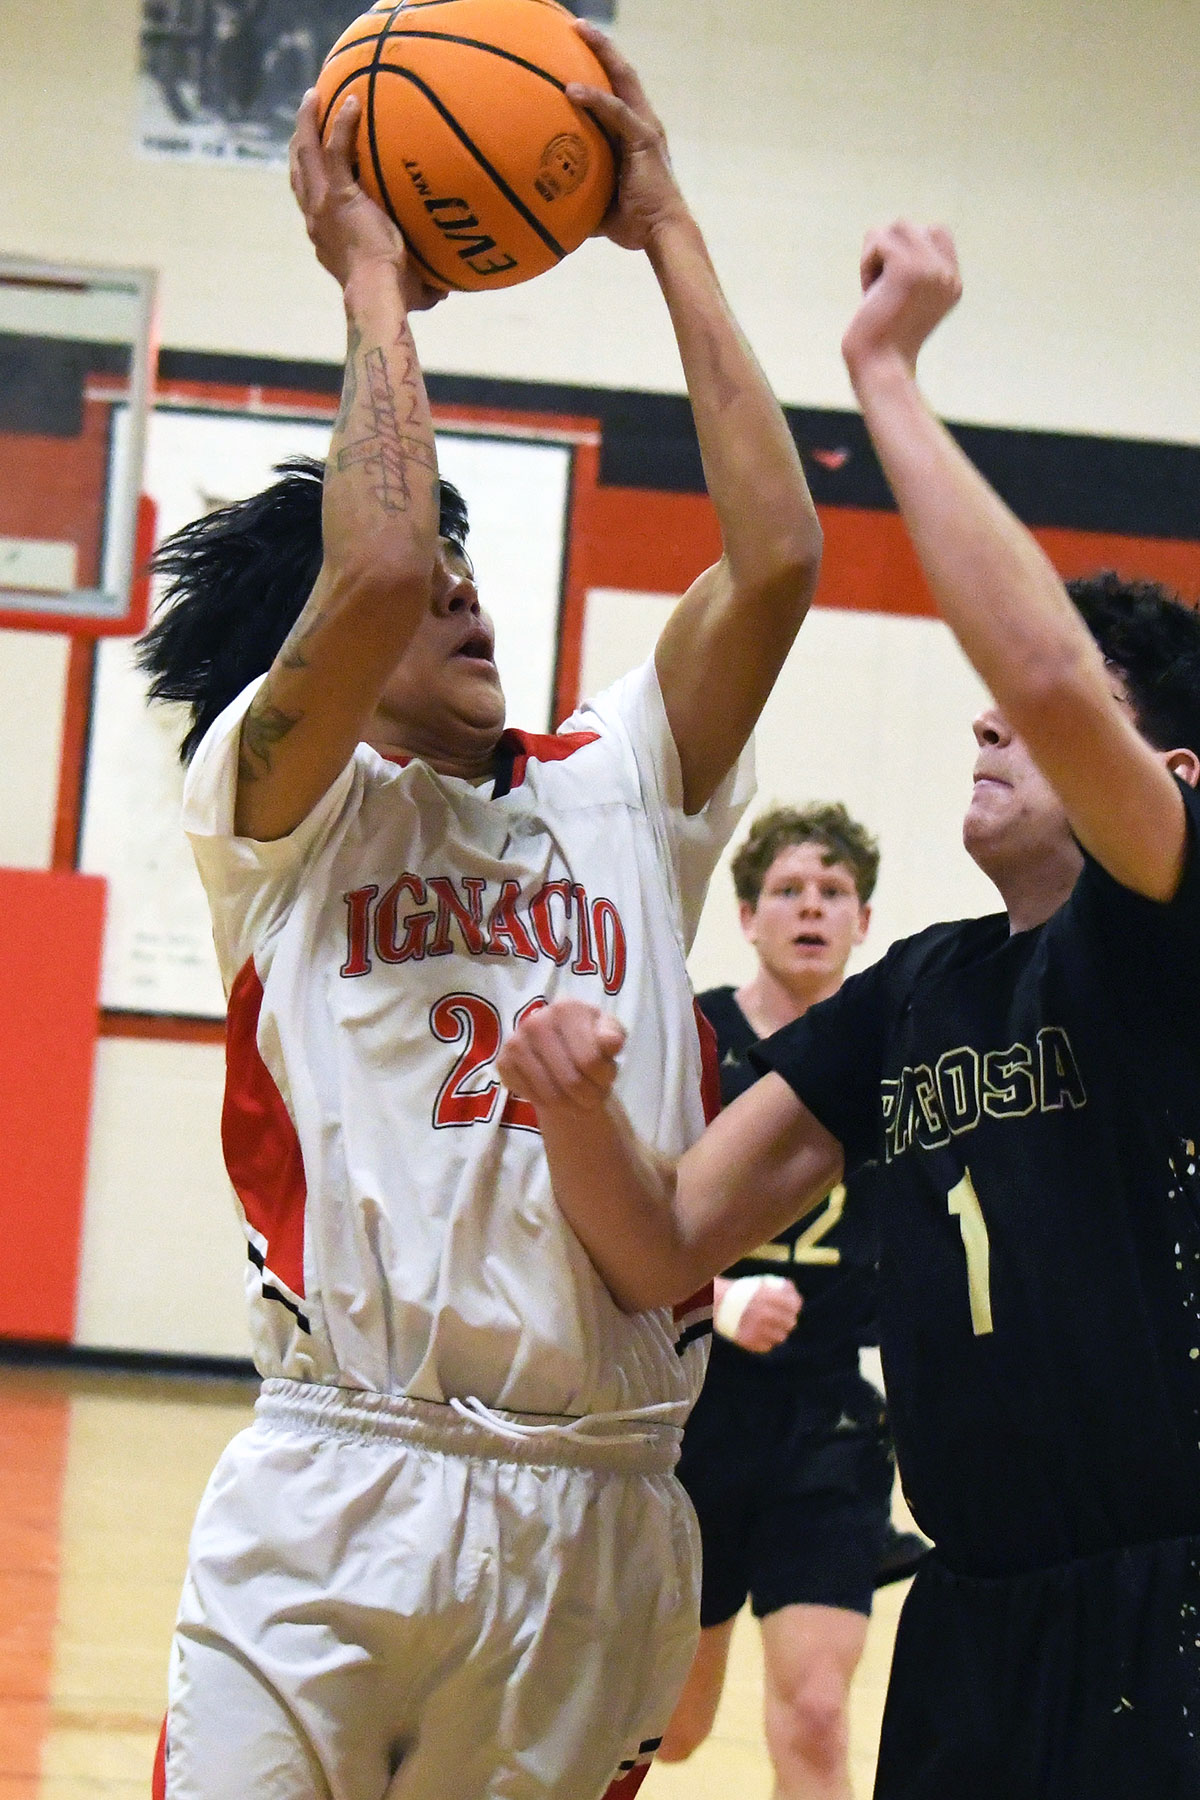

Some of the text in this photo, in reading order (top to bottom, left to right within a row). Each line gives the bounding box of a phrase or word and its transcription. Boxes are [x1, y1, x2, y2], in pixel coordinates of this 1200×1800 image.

[424, 197, 518, 275] EVO
[340, 872, 627, 996] IGNACIO
[738, 1183, 847, 1265] 2
[947, 1165, 993, 1337] 1
